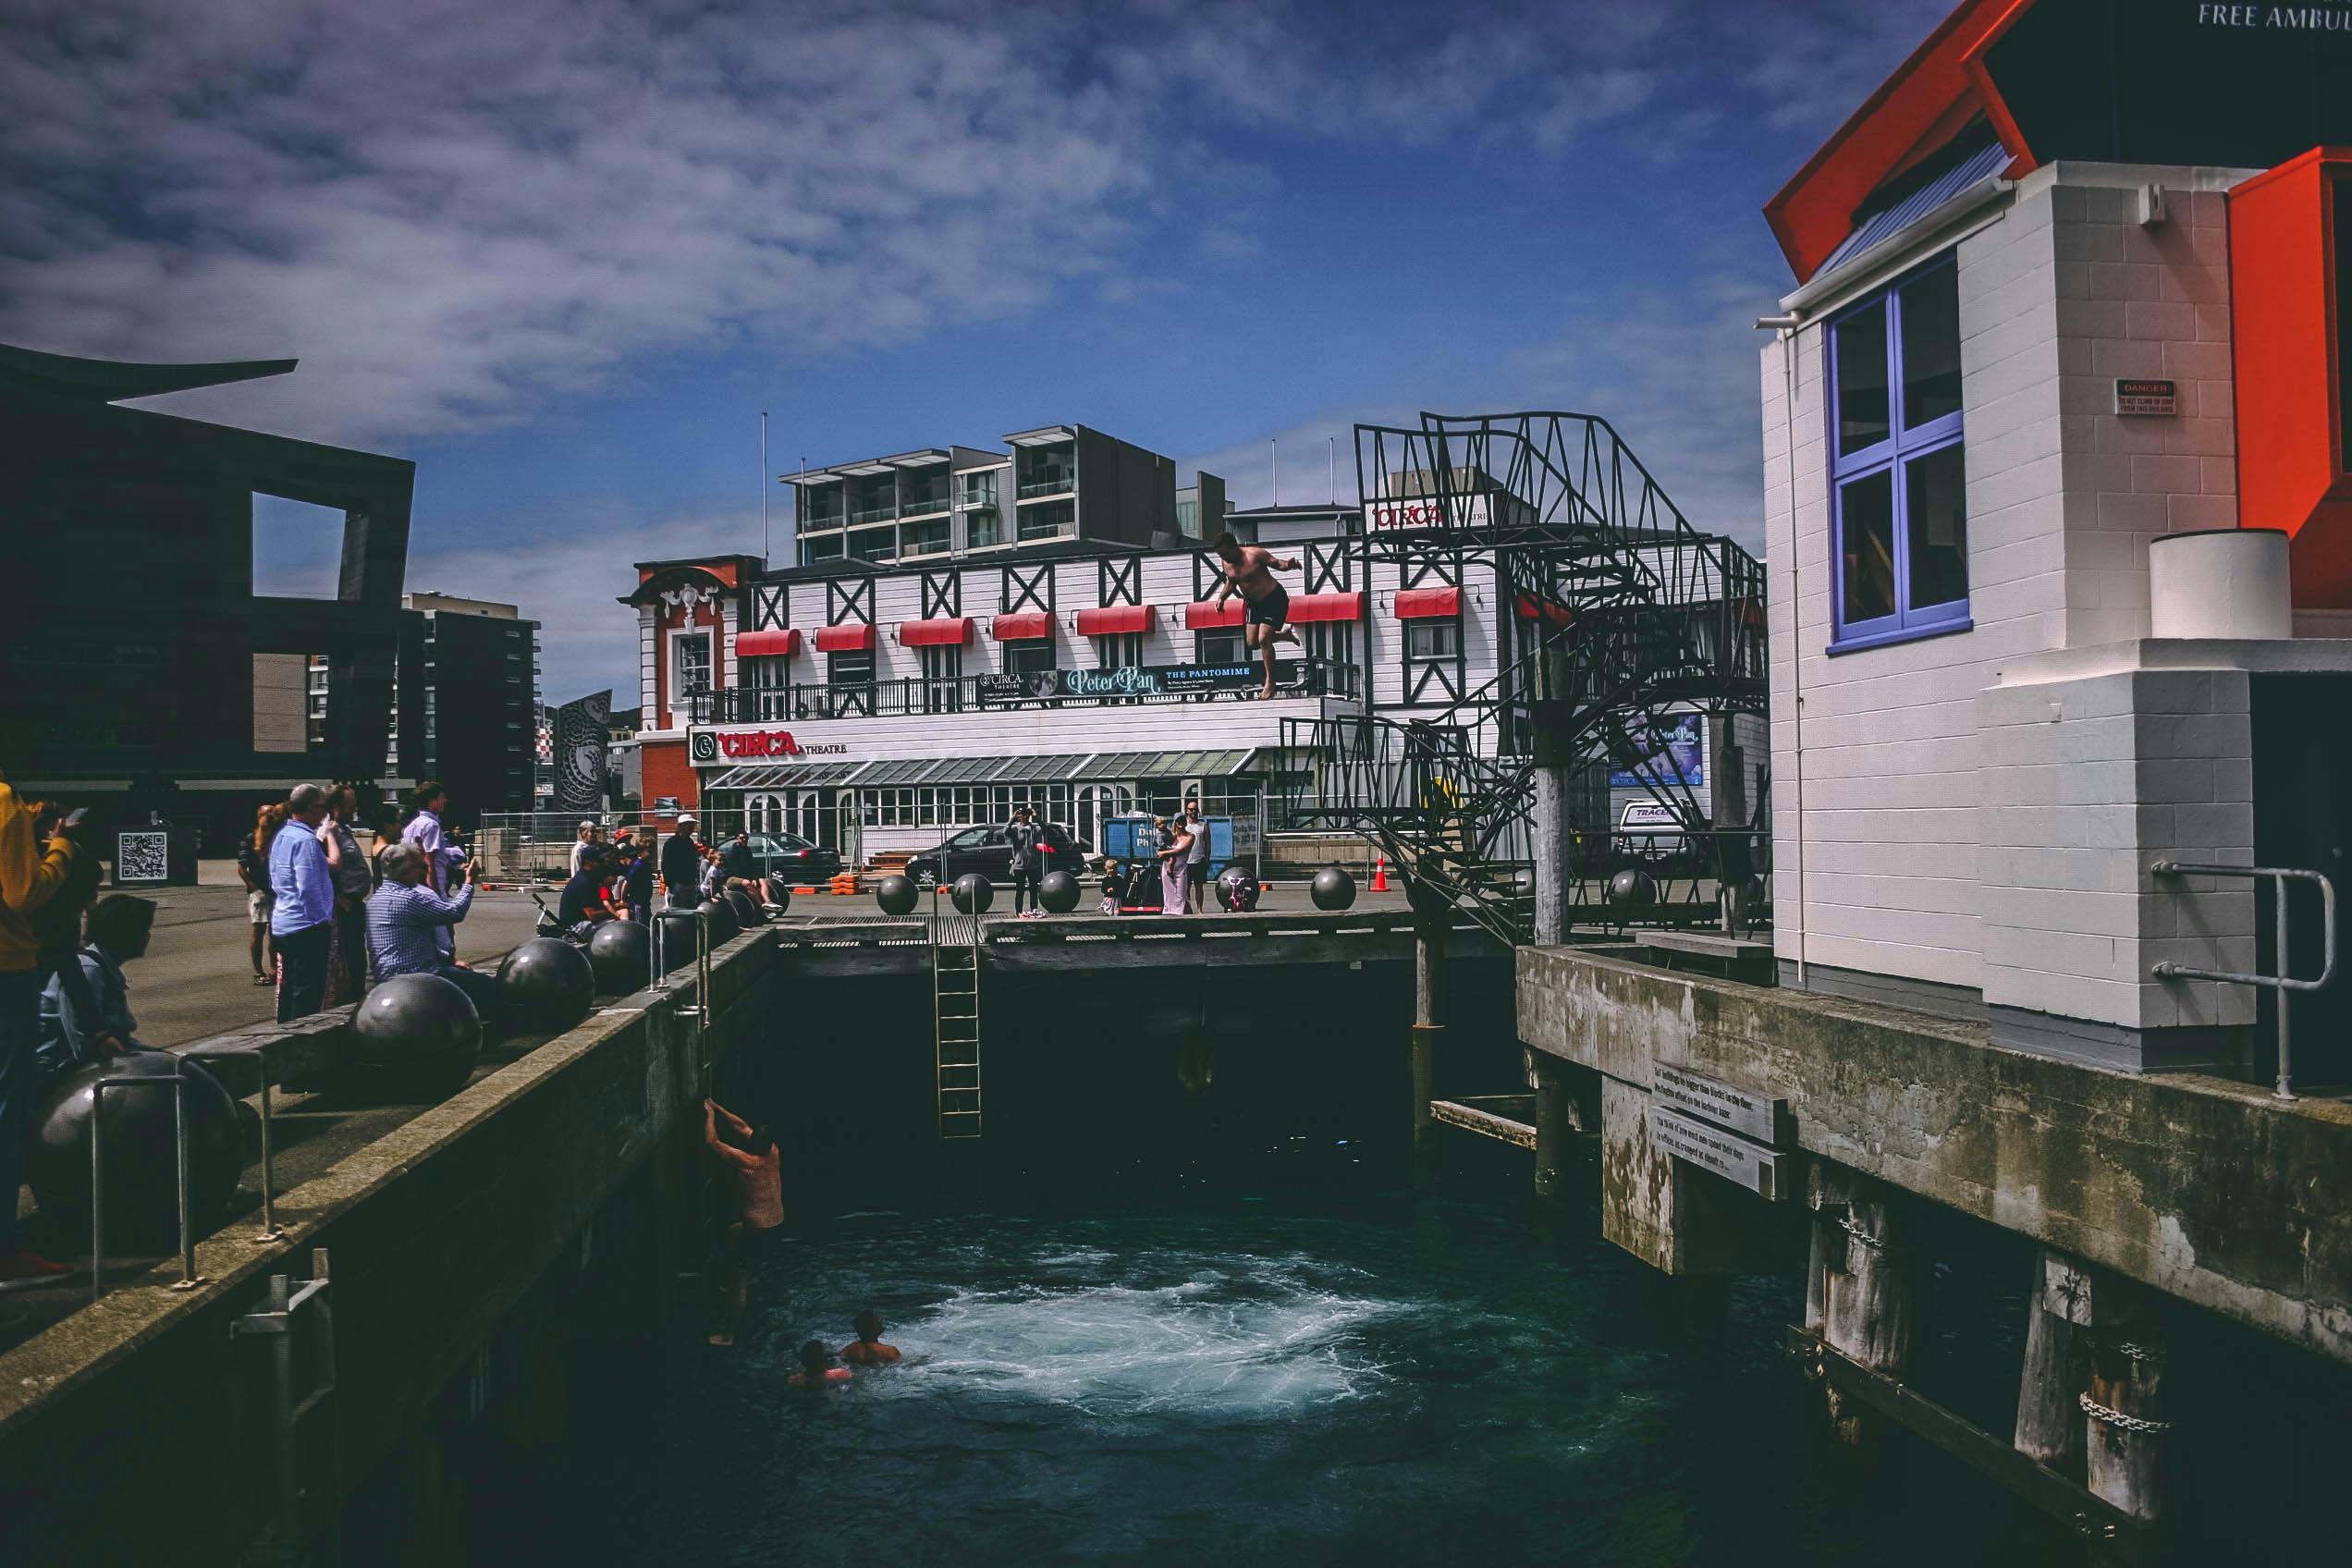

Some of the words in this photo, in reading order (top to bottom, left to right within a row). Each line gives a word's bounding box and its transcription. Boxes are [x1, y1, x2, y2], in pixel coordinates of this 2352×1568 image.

[2199, 4, 2257, 27] FREE
[2125, 384, 2167, 392] DANGER
[989, 673, 1023, 685] CIRCA
[1067, 668, 1118, 694] Peter
[1116, 666, 1161, 695] Pan
[1189, 668, 1250, 678] PANTOMIME
[717, 730, 805, 757] CIRCA
[805, 744, 847, 755] THEATRE
